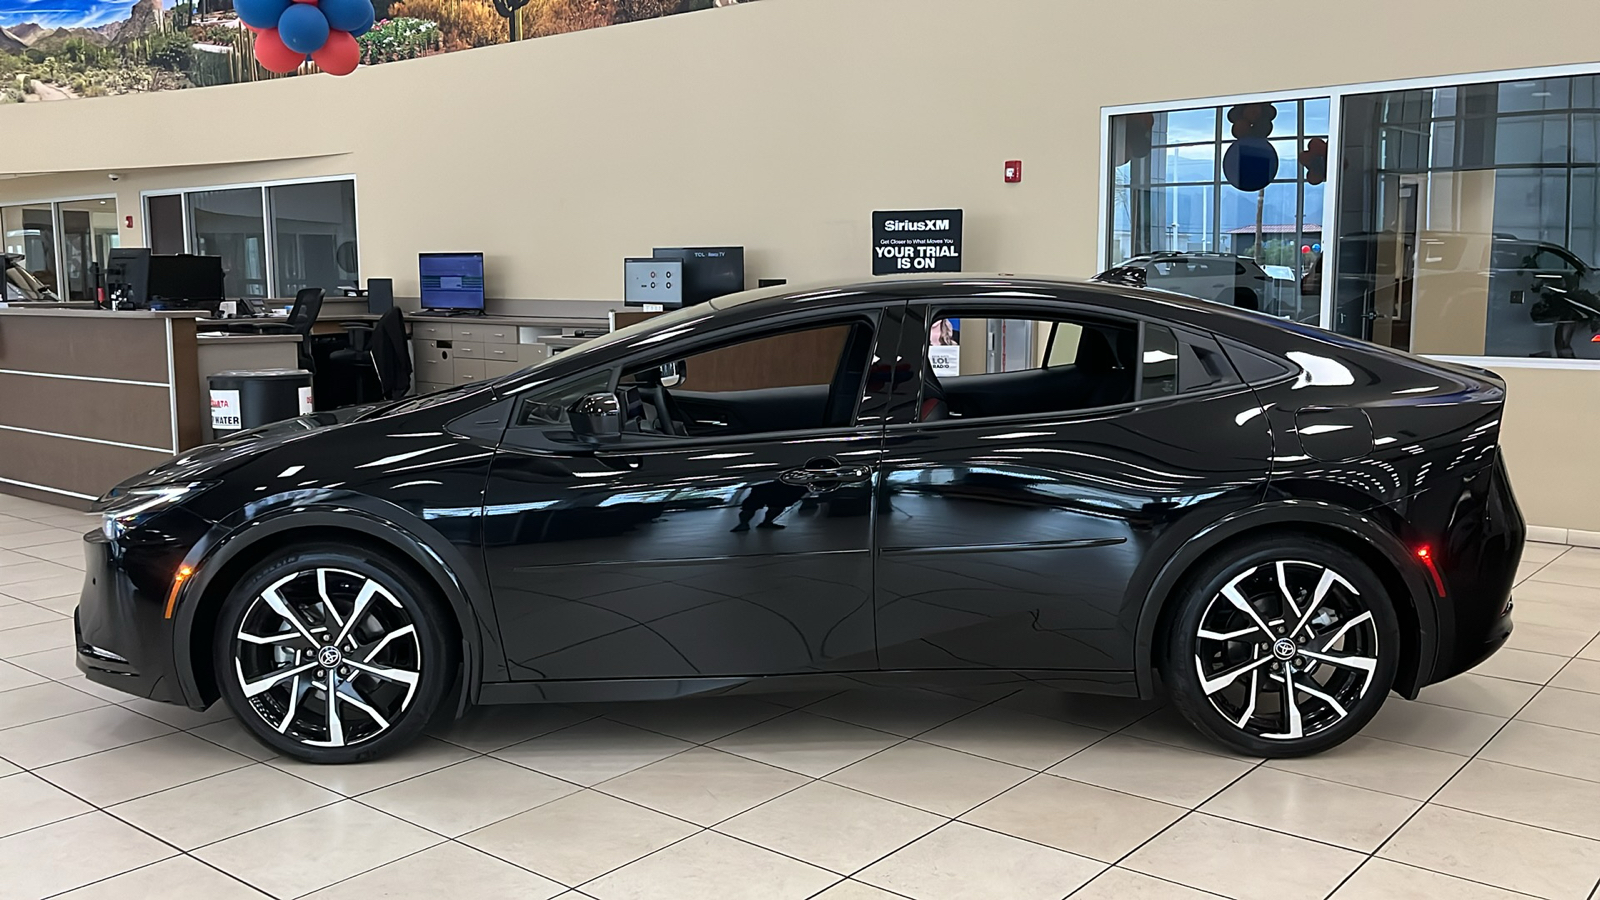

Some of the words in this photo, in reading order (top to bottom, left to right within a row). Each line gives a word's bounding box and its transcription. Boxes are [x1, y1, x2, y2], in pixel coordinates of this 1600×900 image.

[884, 220, 950, 231] SiriusXM
[875, 246, 914, 258] YOUR
[917, 246, 958, 257] TRIAL
[897, 258, 911, 268] IS
[913, 258, 936, 268] ON
[215, 416, 240, 424] WATER
